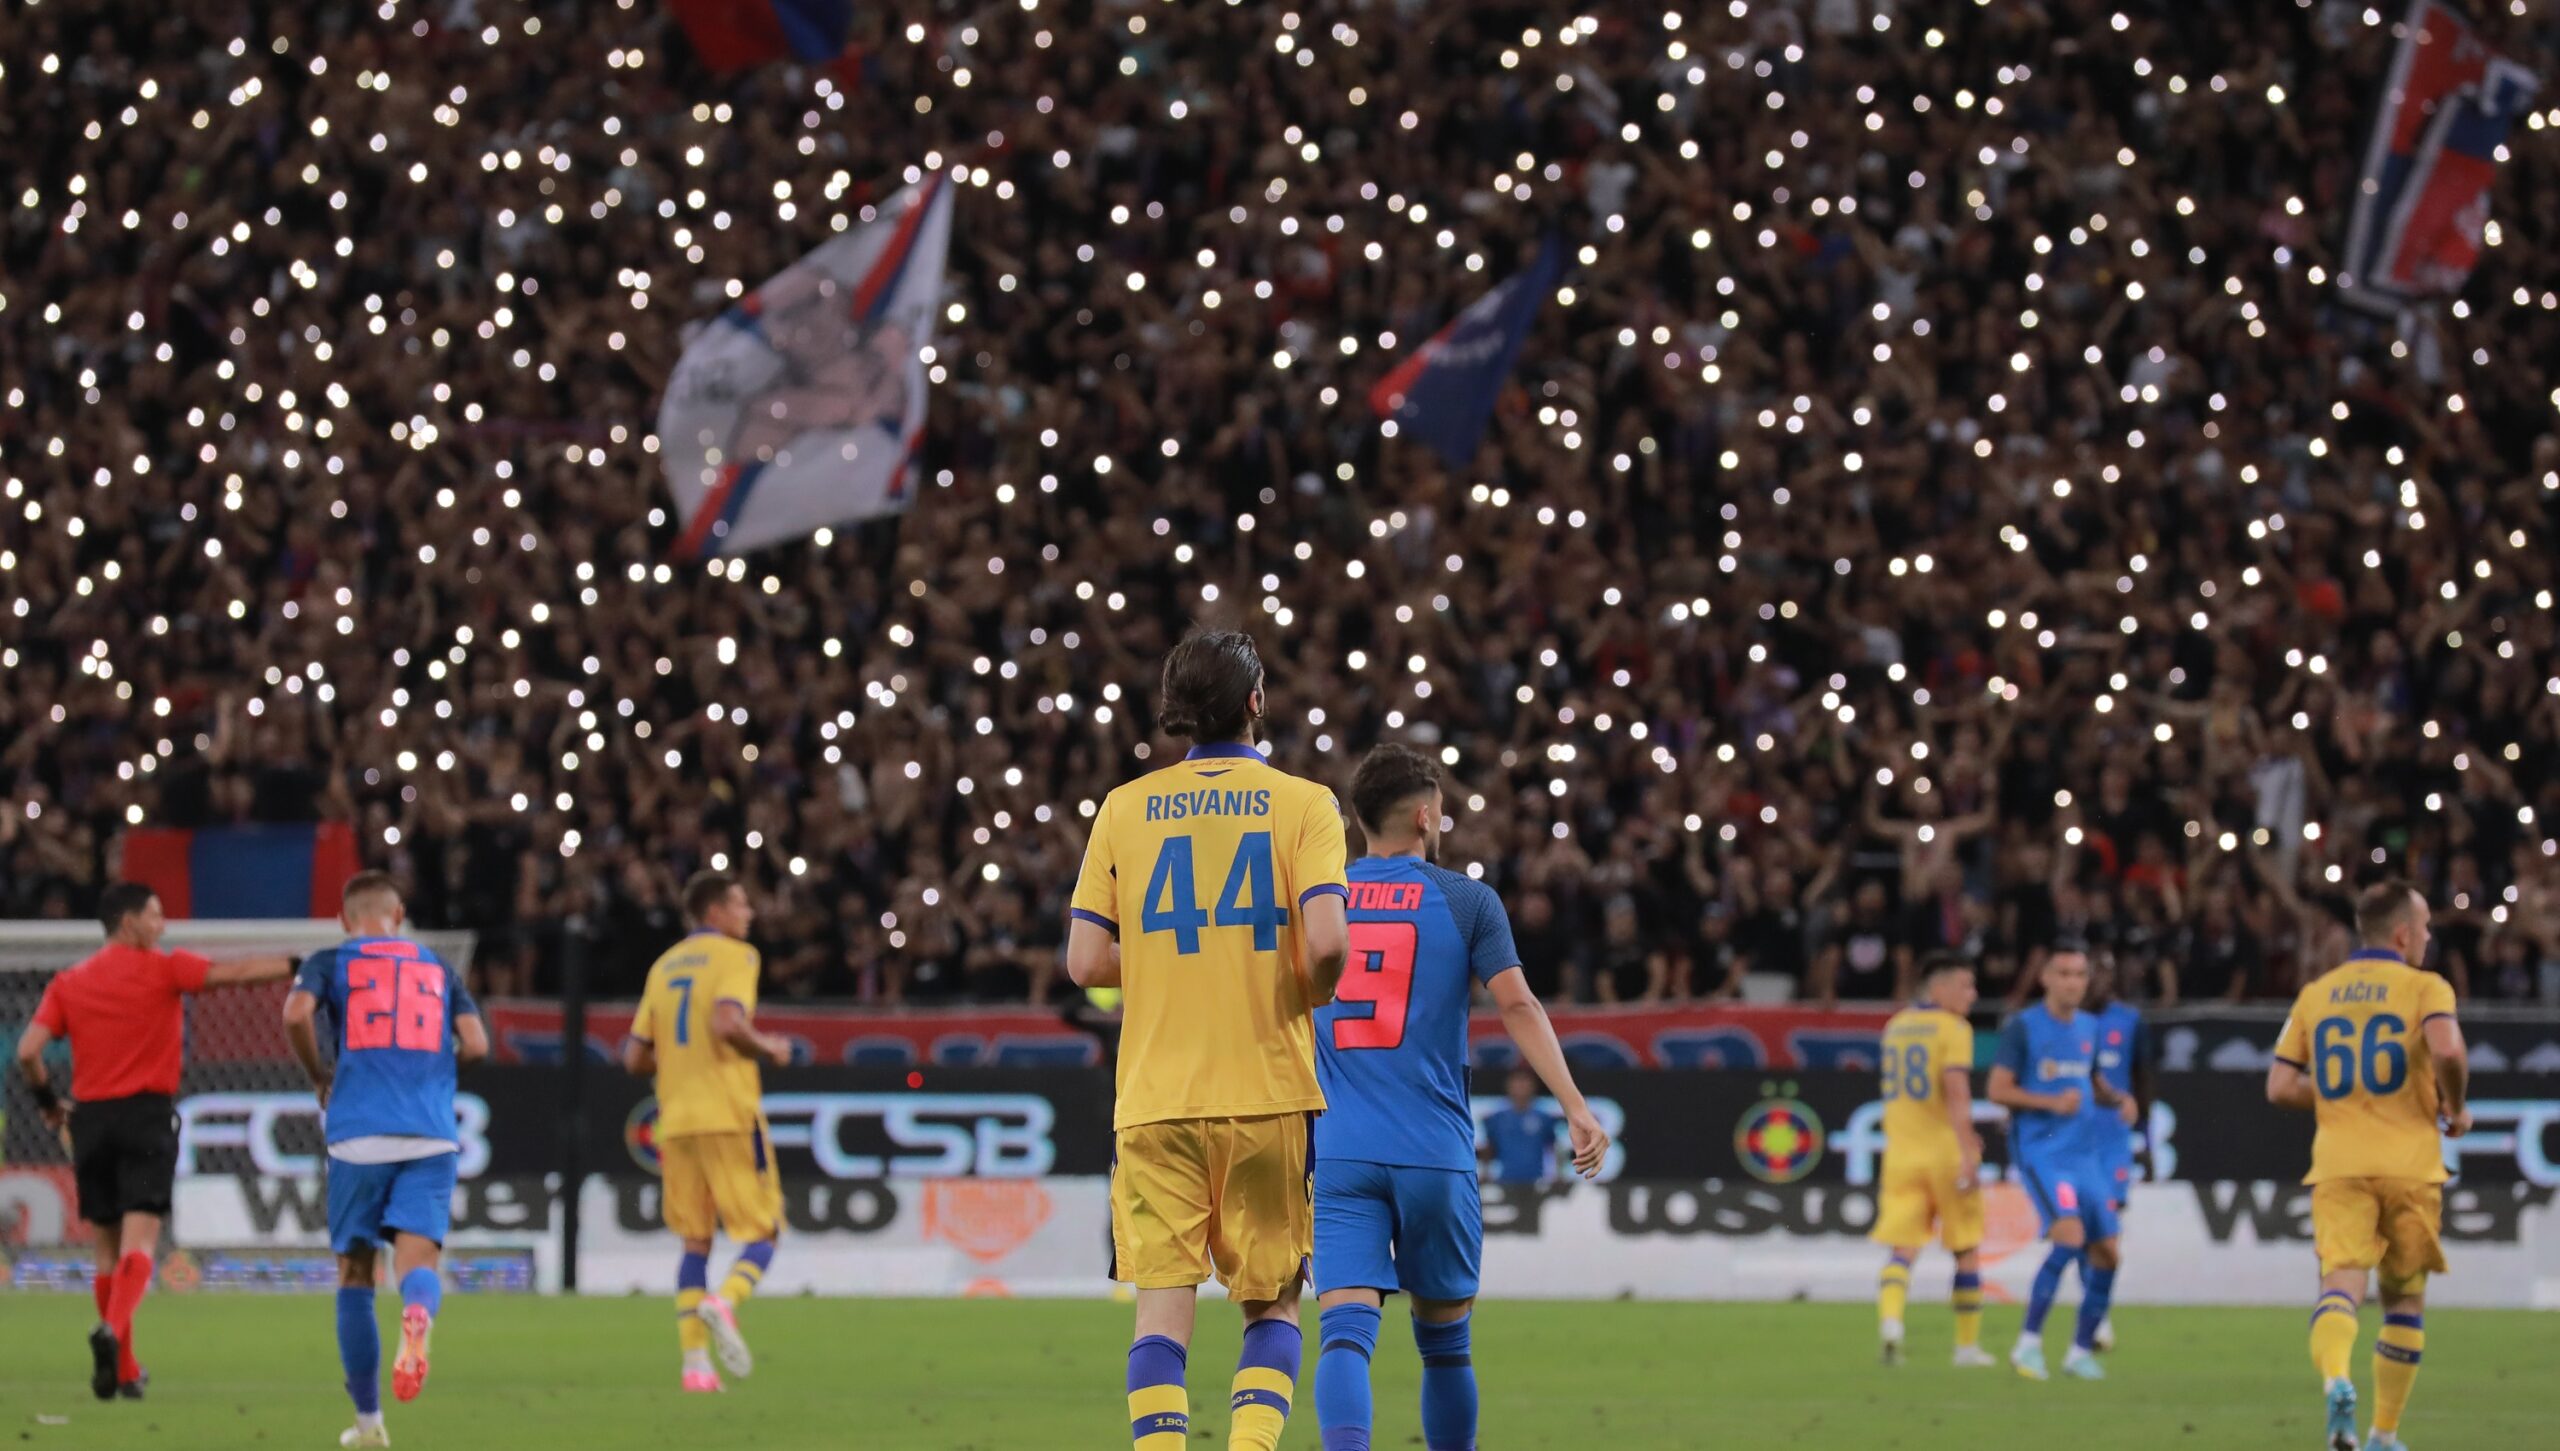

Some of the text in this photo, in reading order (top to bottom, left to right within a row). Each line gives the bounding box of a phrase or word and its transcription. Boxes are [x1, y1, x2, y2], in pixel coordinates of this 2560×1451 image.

[1146, 790, 1271, 822] RISVANIS
[1142, 831, 1288, 955] 44
[1348, 881, 1424, 910] TOICA
[346, 957, 445, 1053] 26
[668, 977, 693, 1045] 7
[1333, 921, 1418, 1050] 9
[2315, 1013, 2407, 1099] 66
